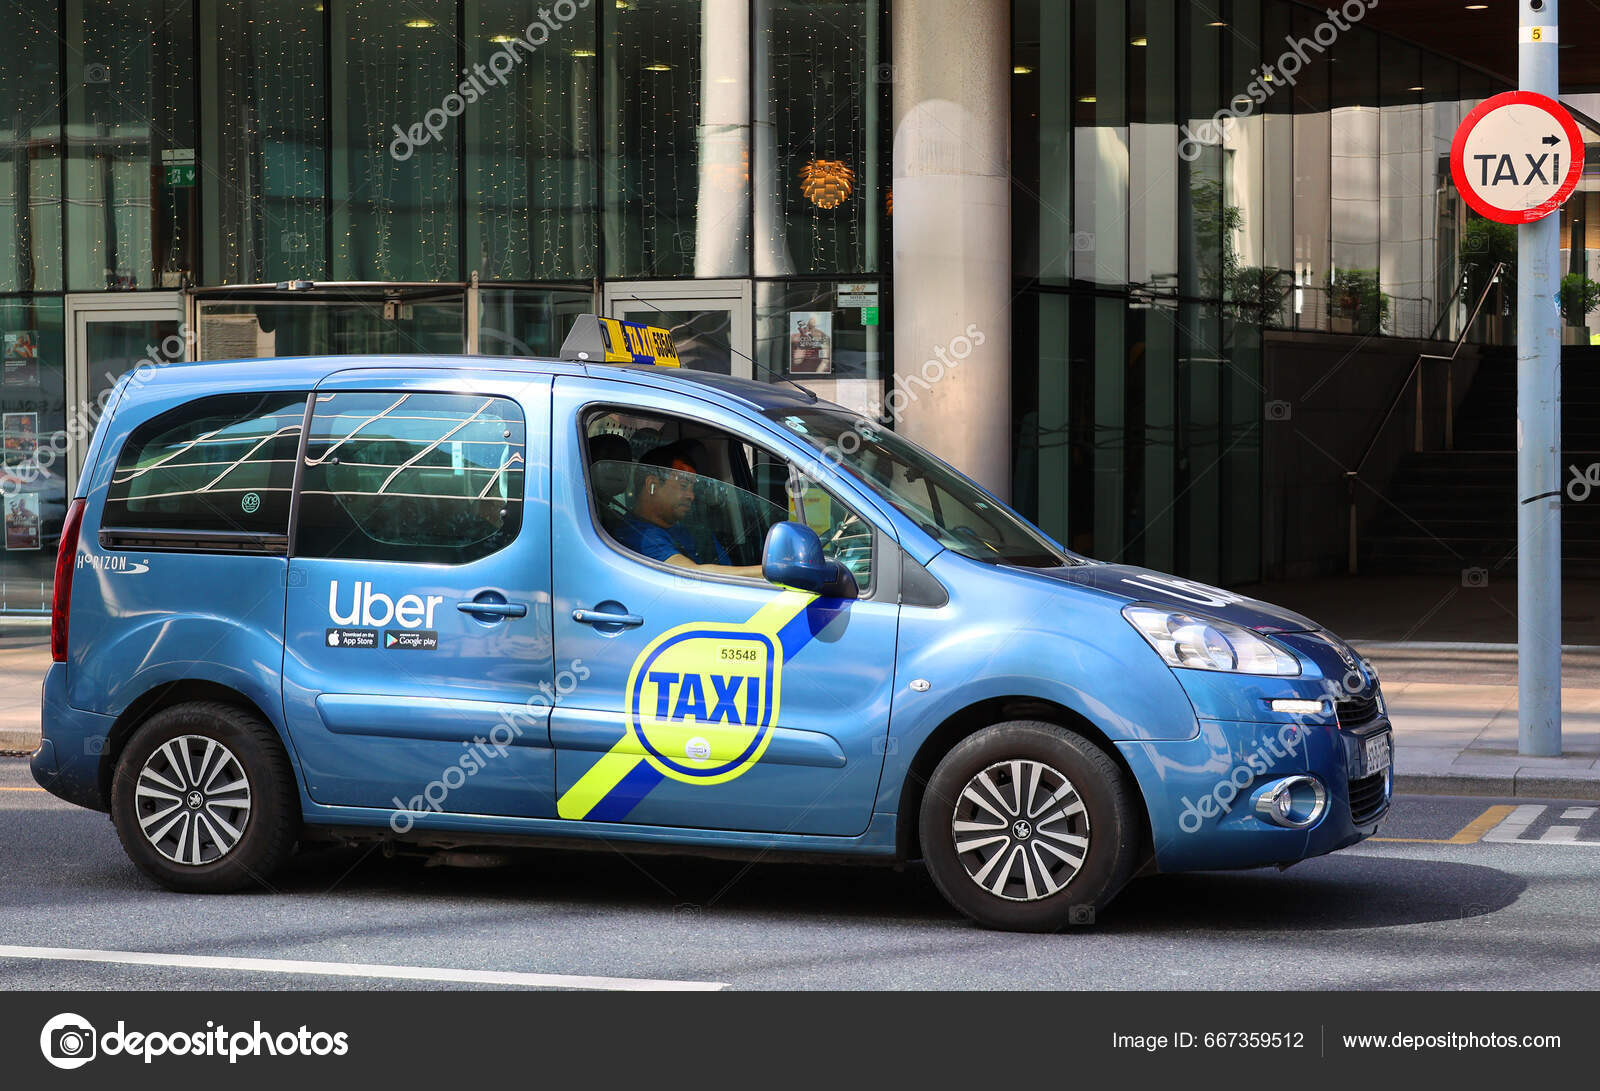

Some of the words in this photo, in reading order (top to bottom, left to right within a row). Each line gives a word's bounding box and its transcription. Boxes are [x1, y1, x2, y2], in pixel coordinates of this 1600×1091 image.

[1532, 28, 1541, 40] 5
[1473, 153, 1560, 186] TAXI
[624, 325, 655, 358] TAXI
[77, 553, 127, 570] HORIZON
[328, 580, 443, 629] Uber
[343, 637, 356, 645] App
[357, 638, 374, 646] Store
[399, 637, 422, 647] Google
[423, 637, 437, 647] play
[721, 648, 757, 661] 53548
[649, 671, 760, 727] TAXI
